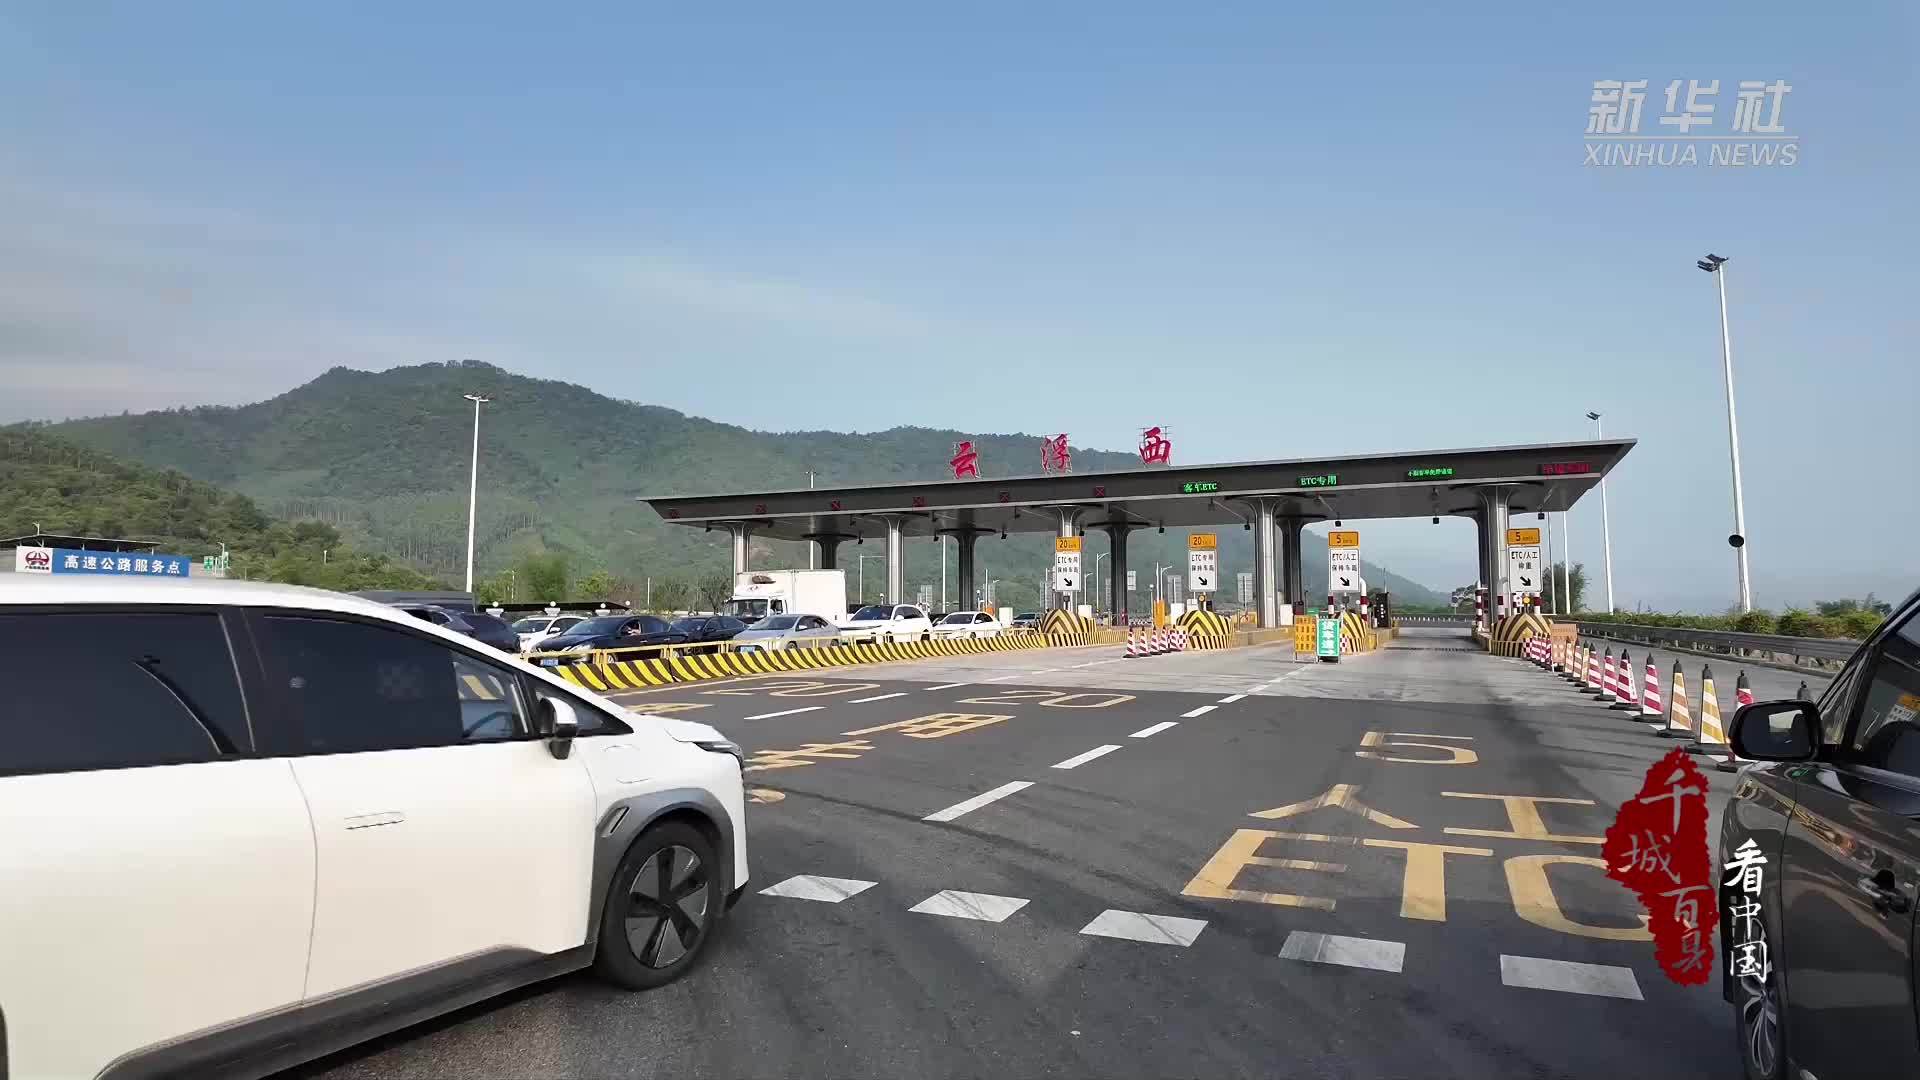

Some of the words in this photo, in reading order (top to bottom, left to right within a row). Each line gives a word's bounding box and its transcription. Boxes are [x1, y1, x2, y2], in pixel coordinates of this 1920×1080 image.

[950, 426, 1172, 480] 云浮西
[1059, 540, 1068, 548] 20
[1193, 536, 1202, 545] 20
[1336, 534, 1342, 544] 5
[1515, 532, 1521, 541] 5
[1332, 553, 1357, 561] ETC/人工
[1511, 551, 1538, 560] ETC/人工
[64, 555, 181, 575] 高速公路服务点
[702, 681, 881, 697] 20
[955, 690, 1137, 708] 20
[1355, 731, 1480, 765] 5
[1247, 783, 1606, 845] 人工
[1180, 828, 1652, 941] ETC
